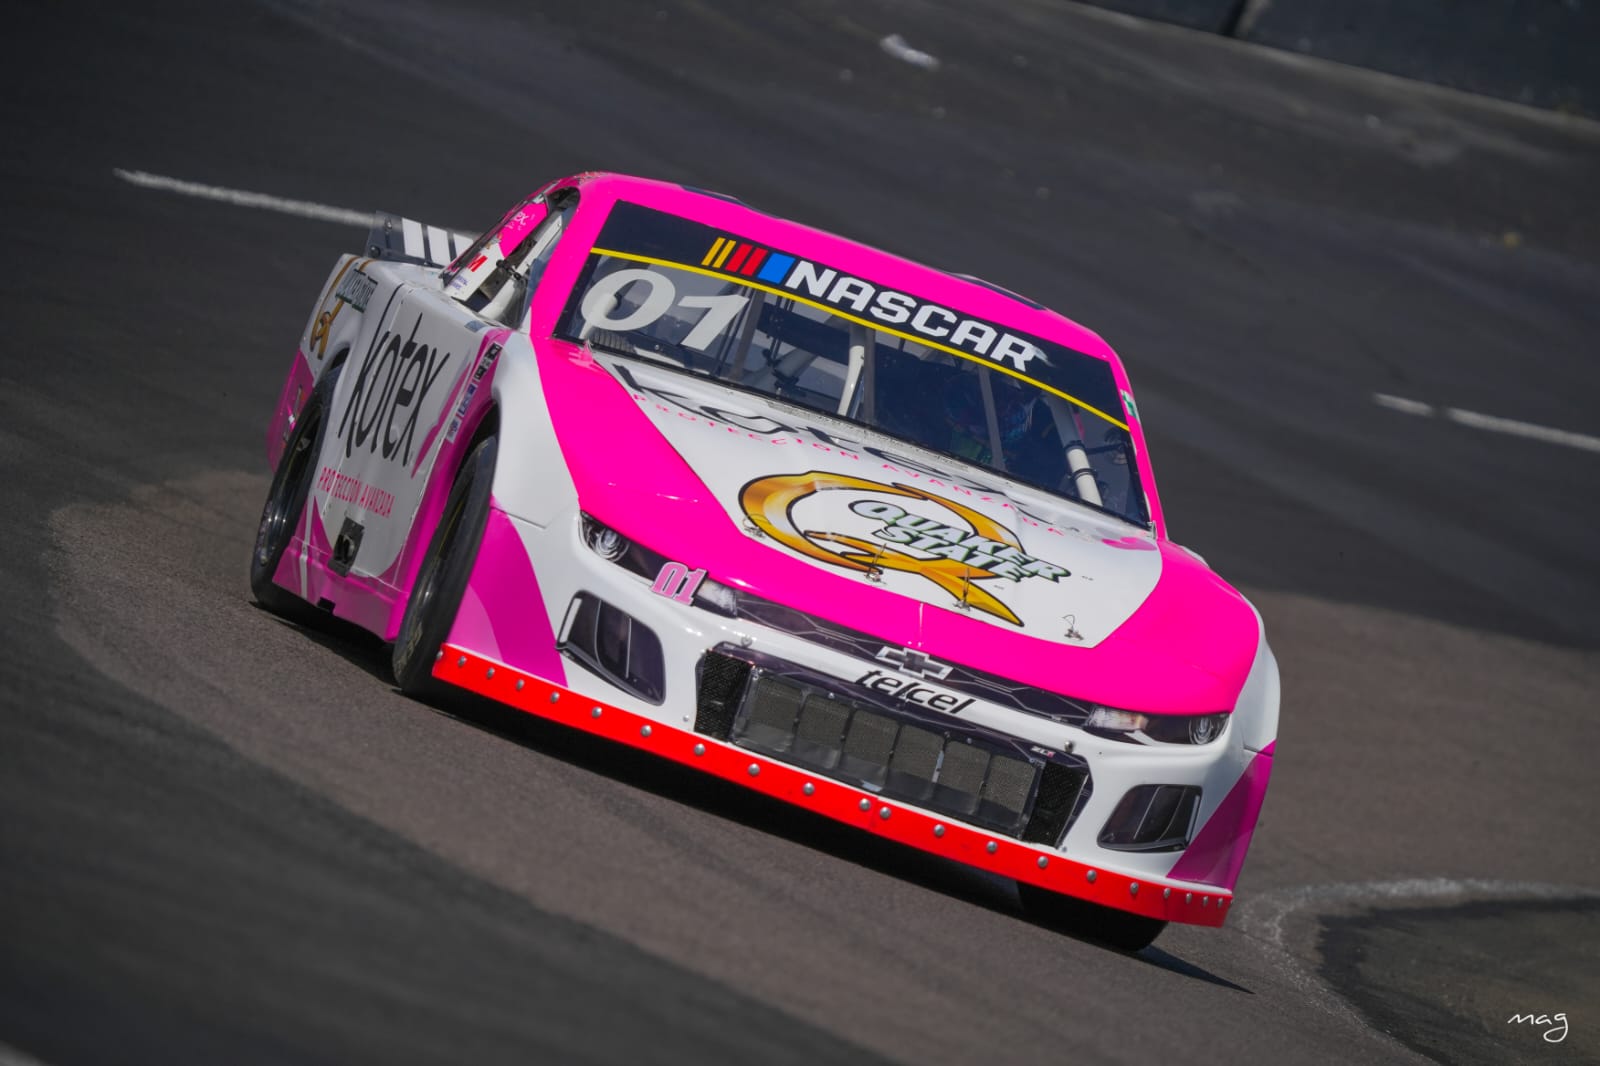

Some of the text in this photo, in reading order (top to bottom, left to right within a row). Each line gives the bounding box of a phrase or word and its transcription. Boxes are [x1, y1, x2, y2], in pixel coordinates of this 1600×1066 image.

[580, 268, 750, 351] 01
[784, 259, 1036, 372] NASCAR
[848, 500, 1072, 583] QUAKER
[872, 525, 1025, 582] STATE
[649, 562, 707, 606] 01
[855, 670, 977, 714] telcel
